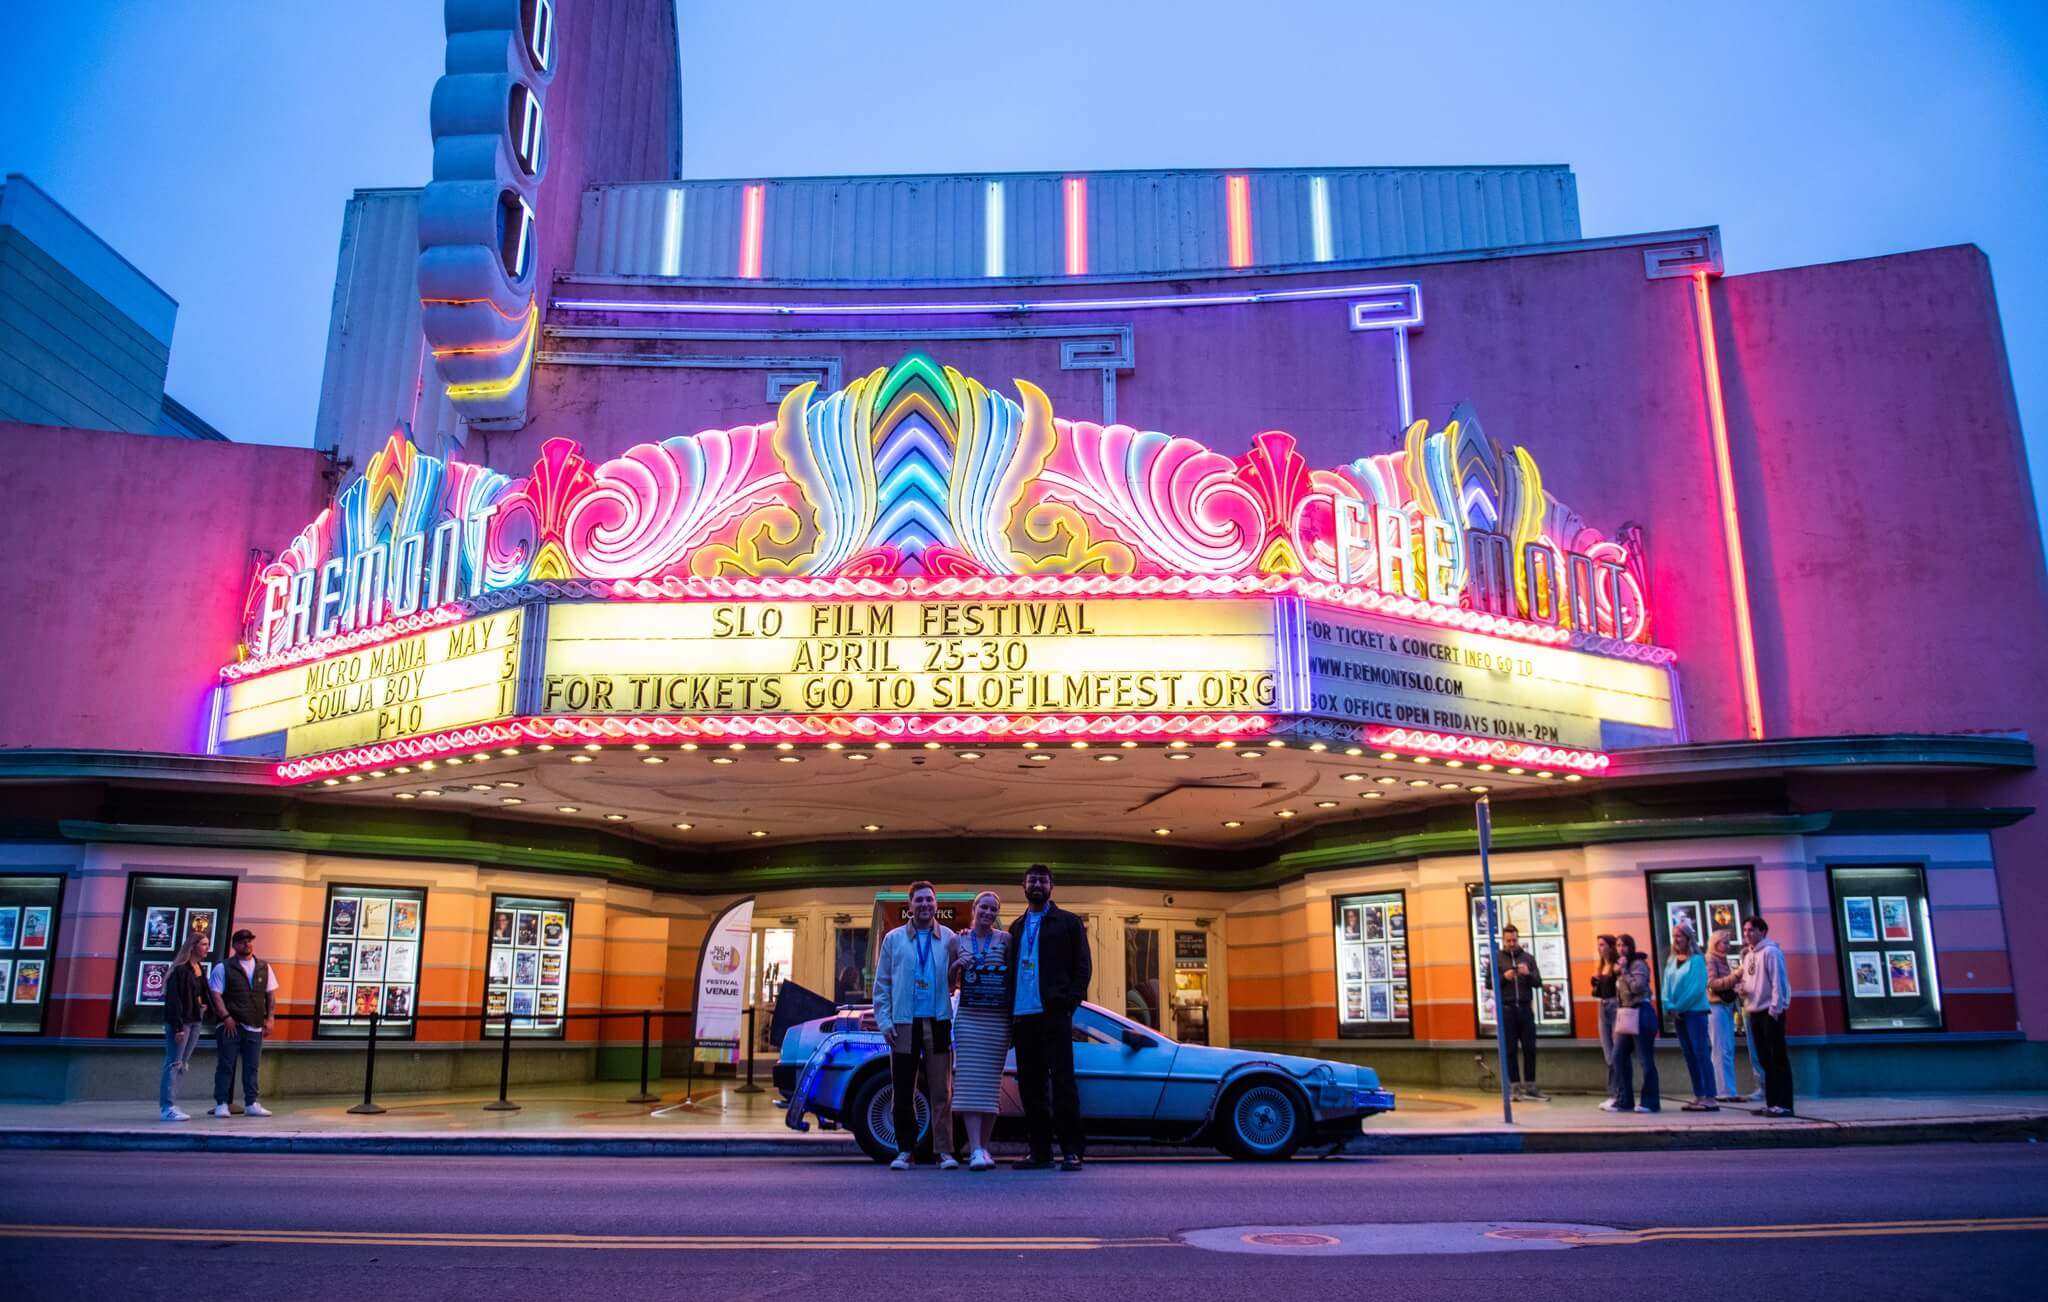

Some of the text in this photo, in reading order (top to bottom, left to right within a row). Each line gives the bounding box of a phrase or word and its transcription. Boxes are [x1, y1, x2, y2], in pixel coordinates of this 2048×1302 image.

[258, 503, 499, 654] FREMONT
[1332, 494, 1628, 641] FREMONT
[712, 602, 1095, 637] SLO FILM FESTIVAL
[305, 614, 519, 695] MICRO MANIA MAY 4
[791, 638, 1028, 672] APRIL 25-30
[1305, 620, 1533, 676] FOR TICKET & CONCERT INFO GO TO
[305, 646, 515, 724] SOULJA BOY 5
[544, 672, 1277, 710] FOR TICKETS GO TO SLOFILMFEST.ORG
[1308, 655, 1464, 697] WWW.FREMONTSLO.COM
[377, 704, 422, 740] P-LO
[1310, 692, 1560, 742] BOX OFFICE OPEN FRIDAYS 10AM-2PM
[705, 987, 739, 996] VENUE
